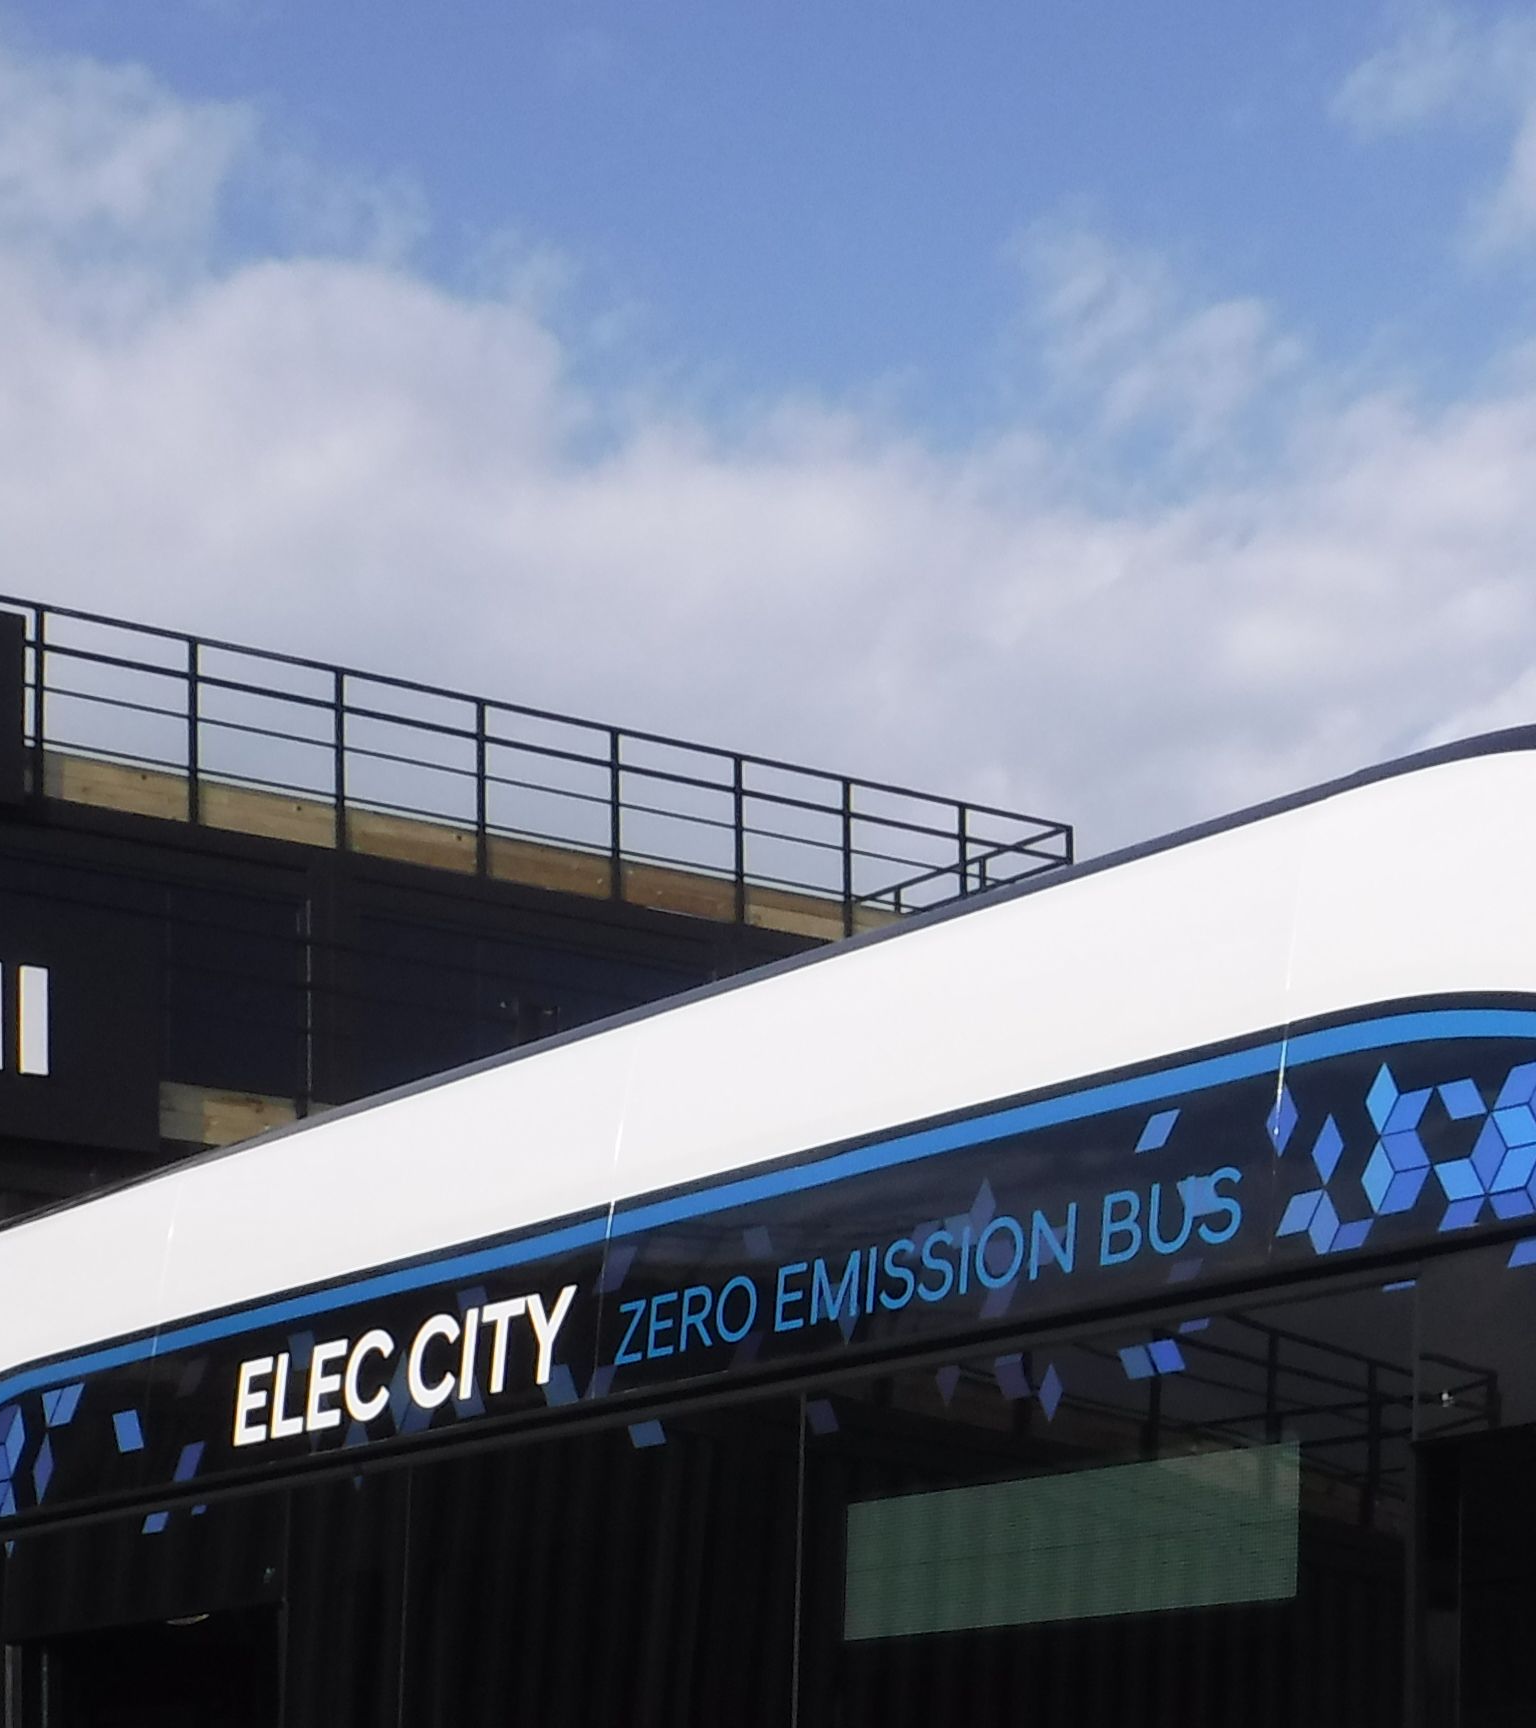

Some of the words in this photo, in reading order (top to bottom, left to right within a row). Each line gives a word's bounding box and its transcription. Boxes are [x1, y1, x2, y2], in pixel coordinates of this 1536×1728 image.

[232, 1328, 395, 1448] ELEC
[407, 1284, 578, 1409] CITY
[614, 1275, 758, 1367] ZERO
[773, 1202, 1079, 1335] EMISSION
[1099, 1166, 1244, 1268] BUS
